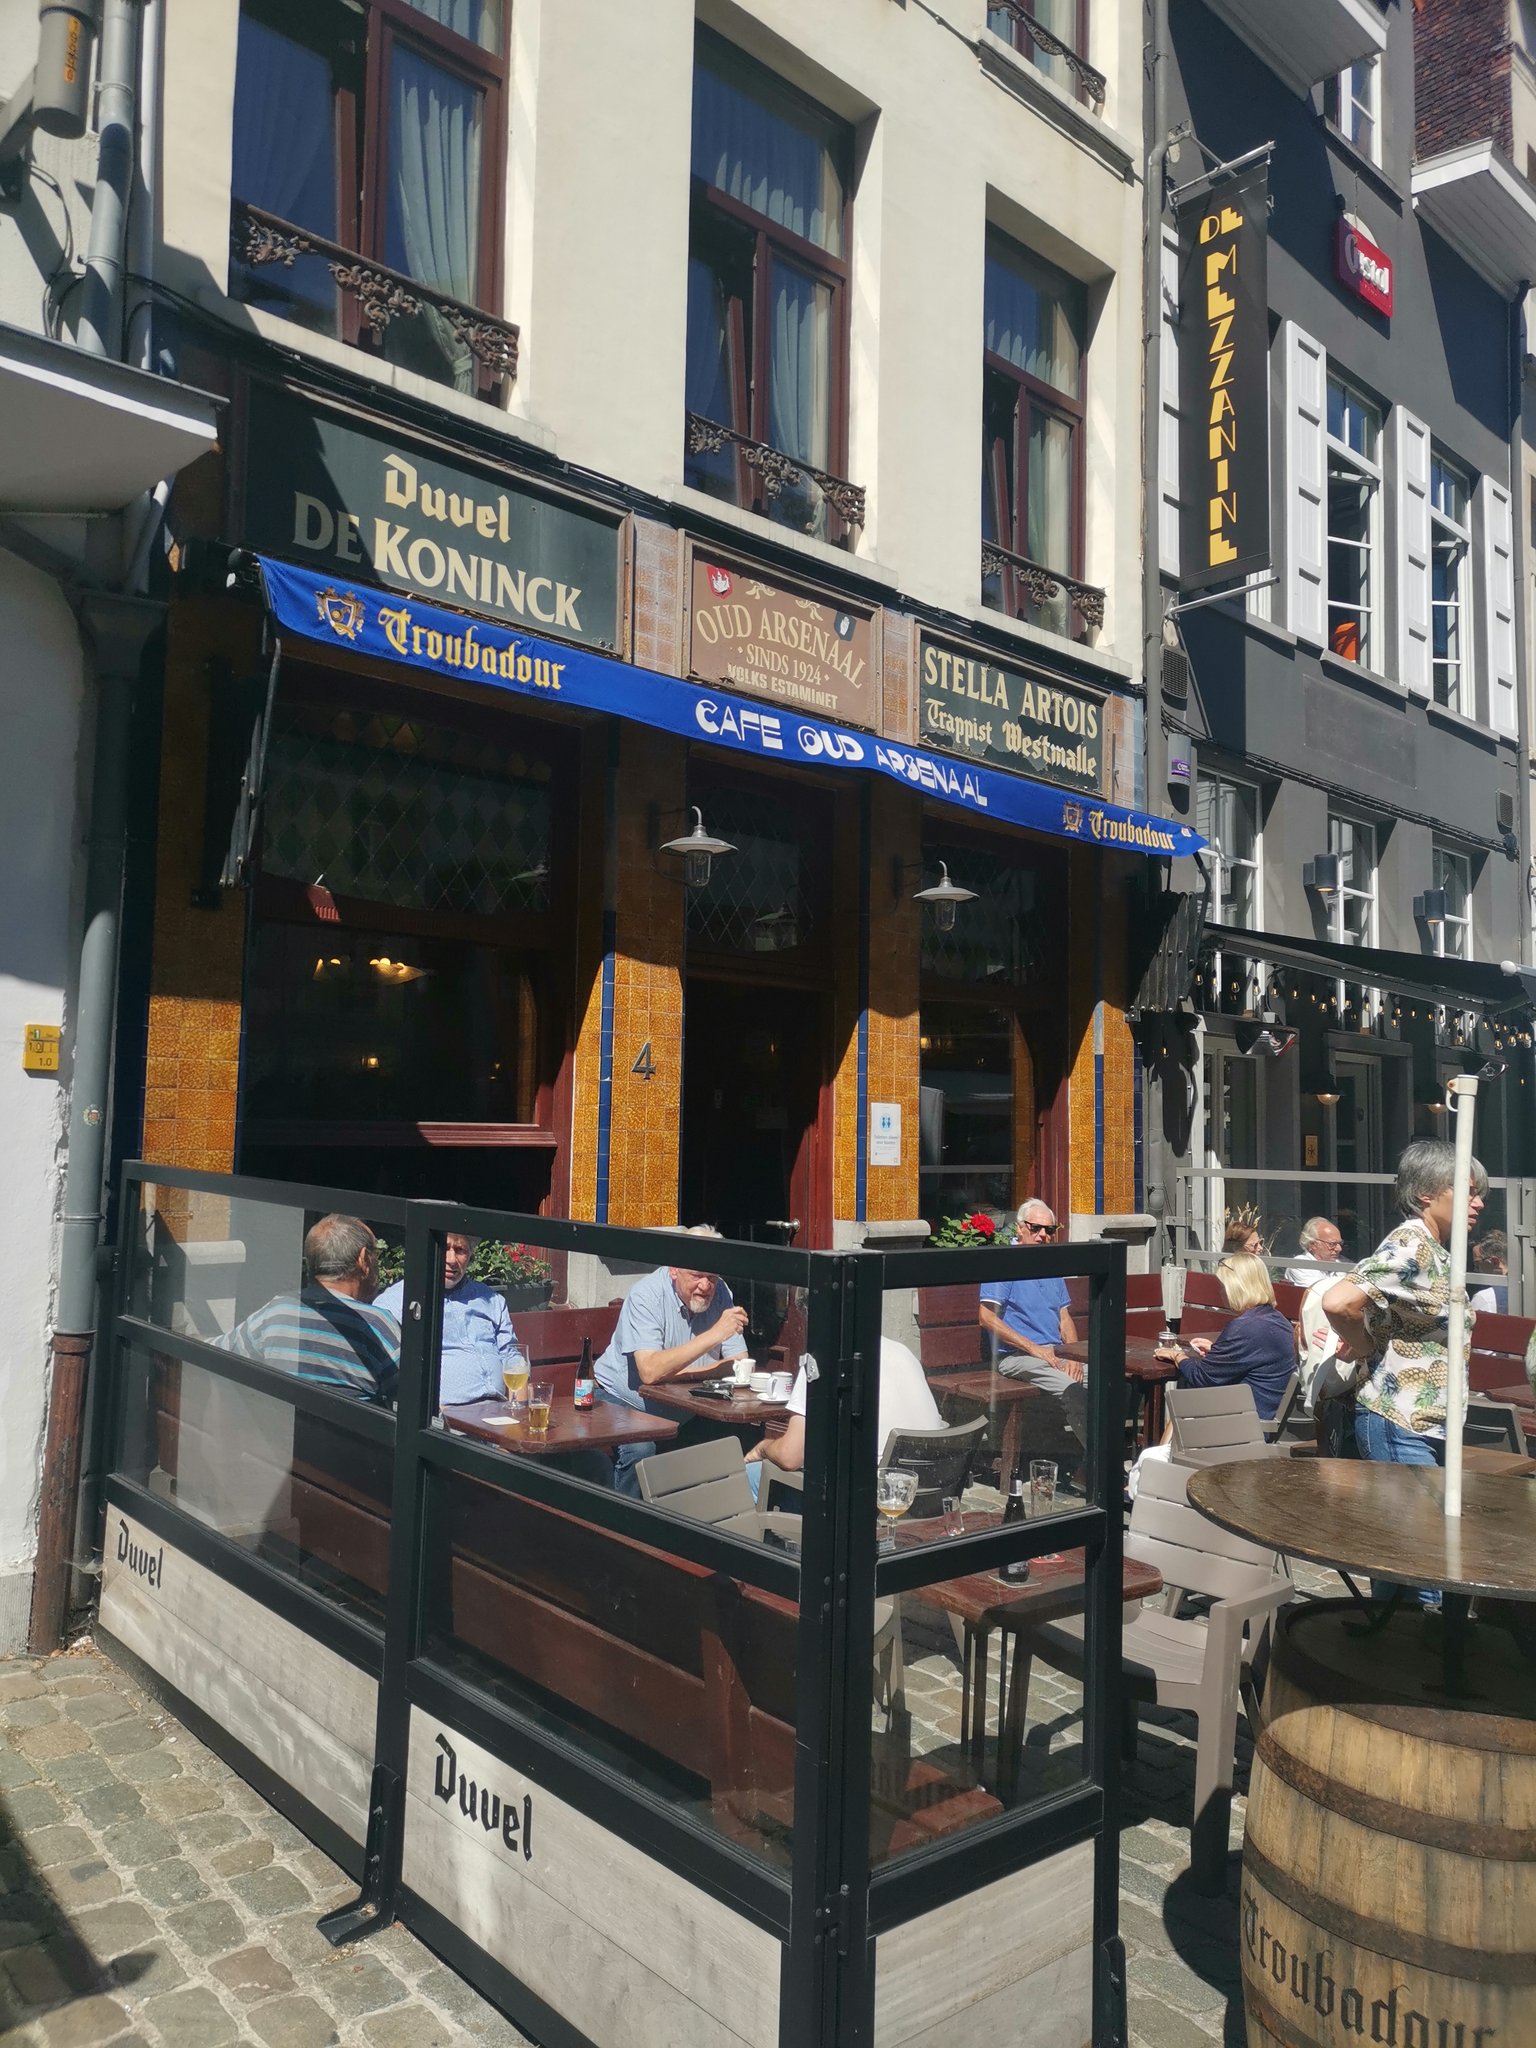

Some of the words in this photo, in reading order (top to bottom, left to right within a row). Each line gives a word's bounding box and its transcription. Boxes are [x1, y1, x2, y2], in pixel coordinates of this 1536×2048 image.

[1200, 206, 1243, 244] DE
[1206, 244, 1238, 567] MEZZANINE
[383, 453, 511, 543] Duvel
[292, 491, 362, 563] DE
[373, 517, 583, 631] KONINCK
[377, 607, 565, 690] Troubadour
[696, 604, 752, 644] OUD
[758, 608, 866, 689] ARSENAAL
[728, 663, 768, 689] VOLKS
[772, 677, 838, 710] ESTAMINET
[746, 643, 789, 678] SINDS
[793, 660, 822, 686] 1924
[924, 646, 1010, 710] STELLA
[1021, 681, 1098, 739] ARTOIS
[695, 699, 783, 750] CAFE
[797, 725, 865, 761] OUD
[876, 745, 988, 806] ARSENAAL
[924, 698, 993, 746] Trappist
[1002, 720, 1097, 777] Westmalle
[1088, 808, 1177, 850] Troubadour
[631, 1041, 656, 1080] 4
[117, 1518, 164, 1589] Duvel
[434, 1732, 533, 1862] Duvel
